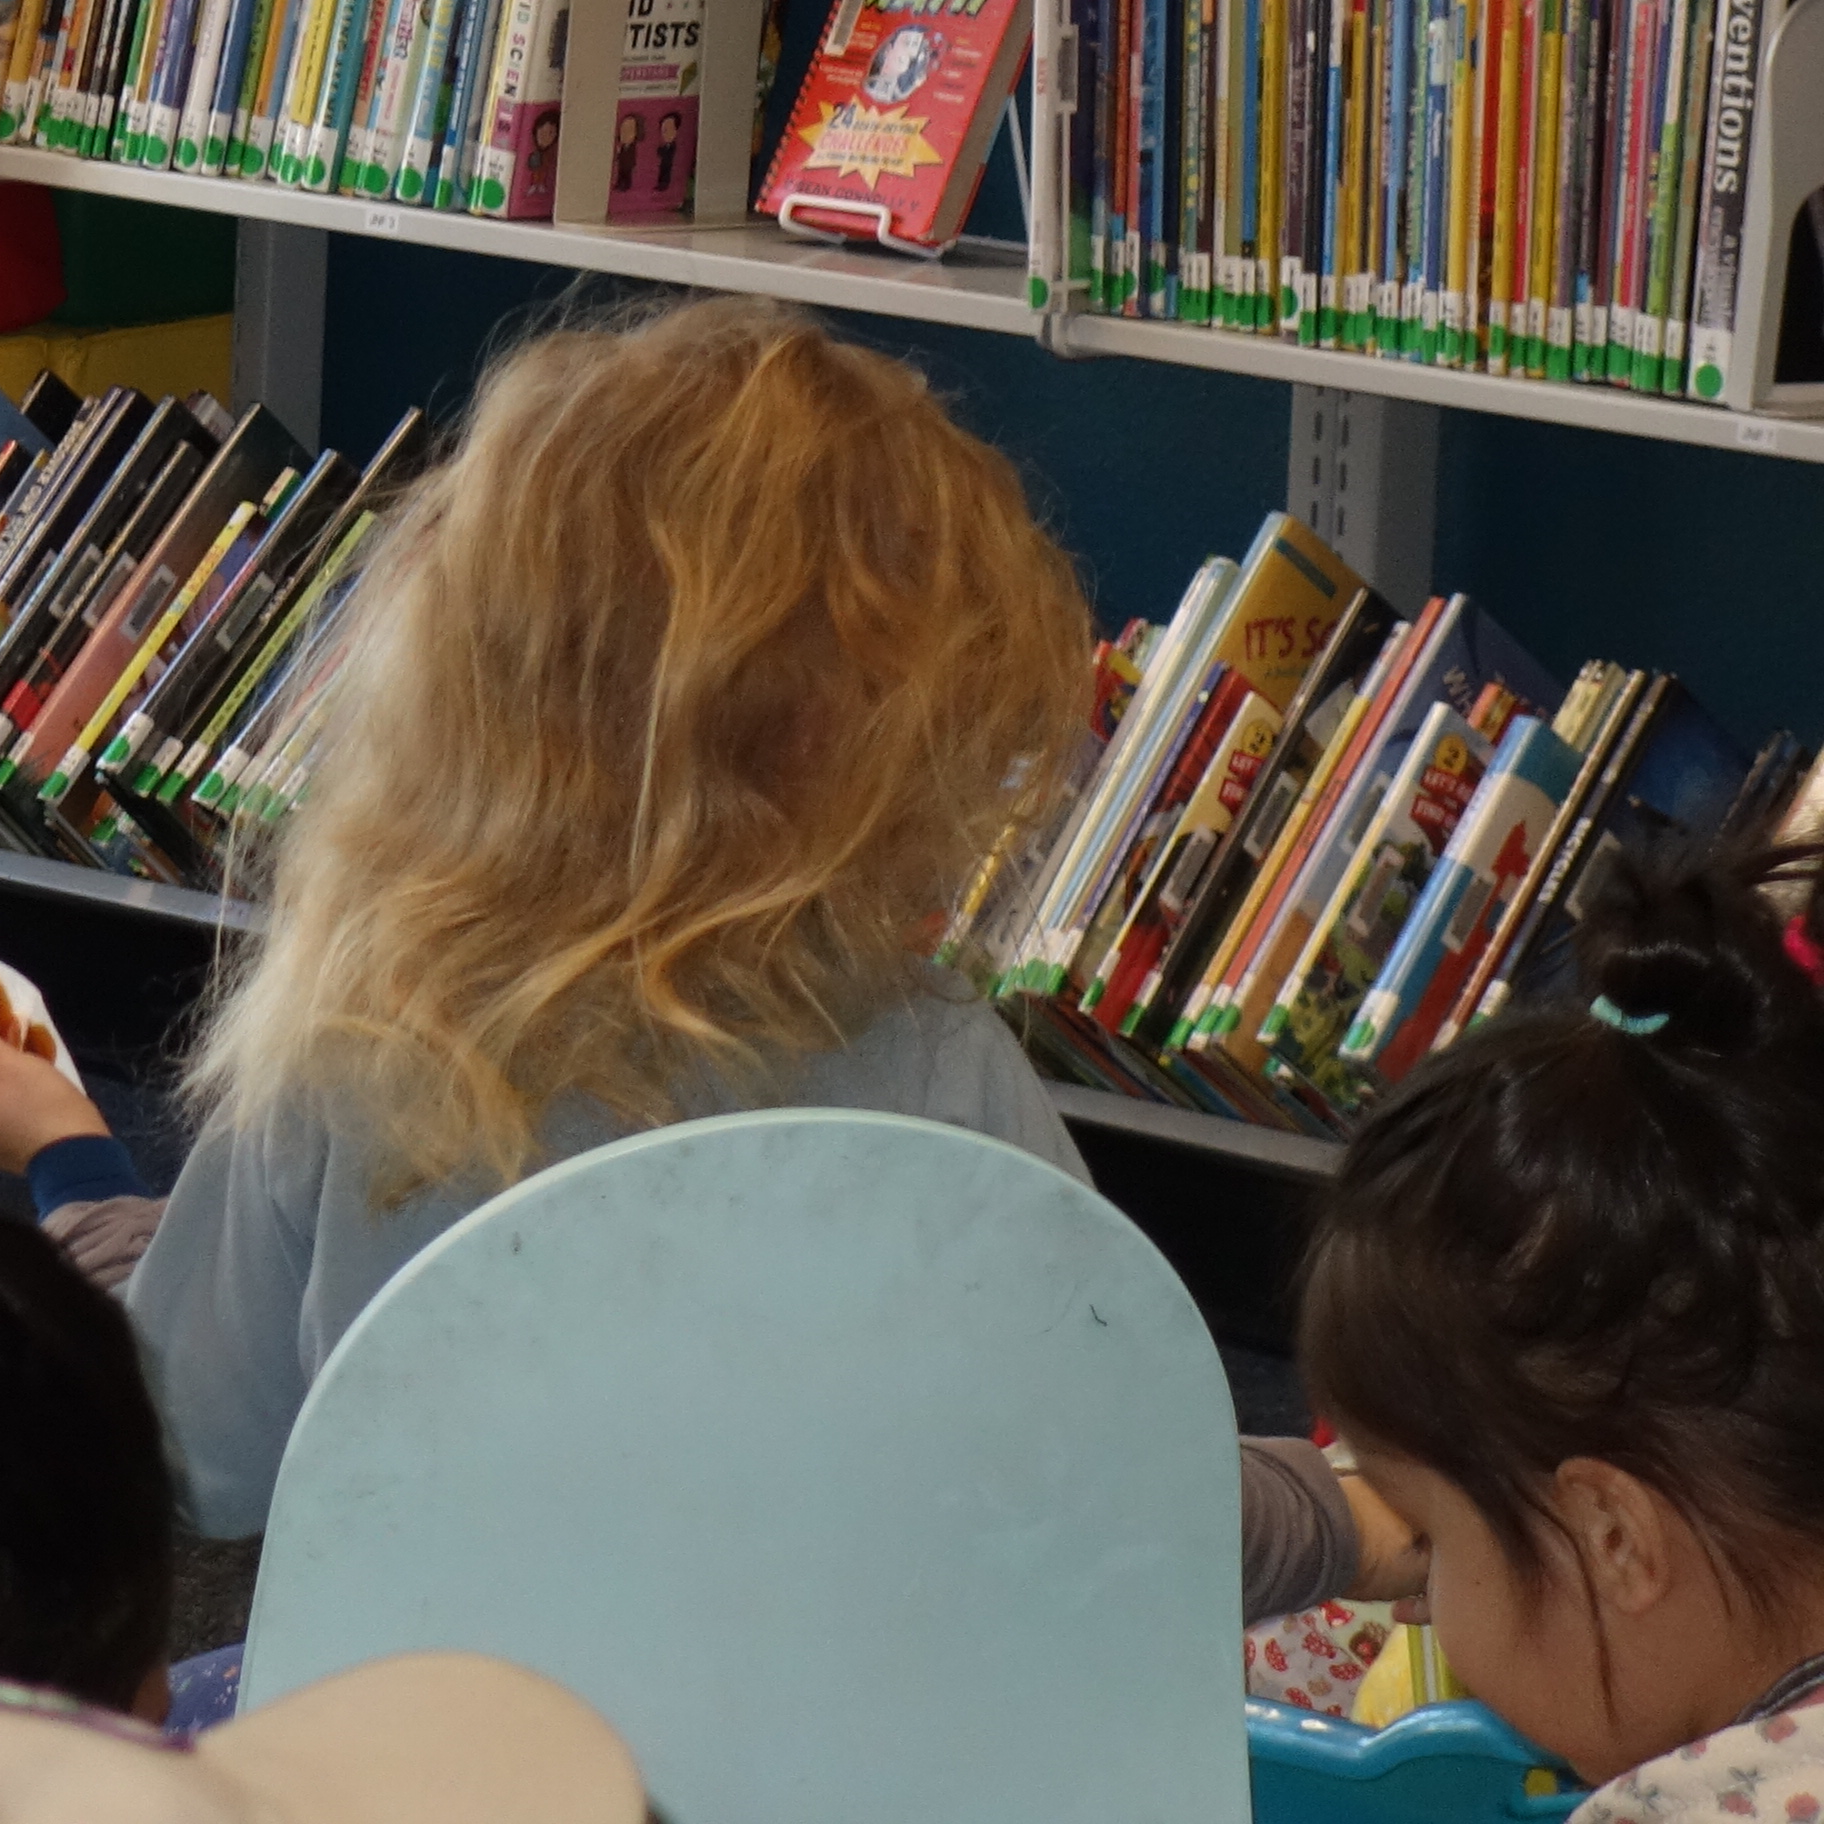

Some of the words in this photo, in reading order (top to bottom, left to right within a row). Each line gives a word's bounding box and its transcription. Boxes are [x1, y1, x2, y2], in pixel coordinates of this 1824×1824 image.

[626, 20, 701, 49] TISTS
[828, 101, 858, 128] 24
[1244, 617, 1296, 661] IT'S
